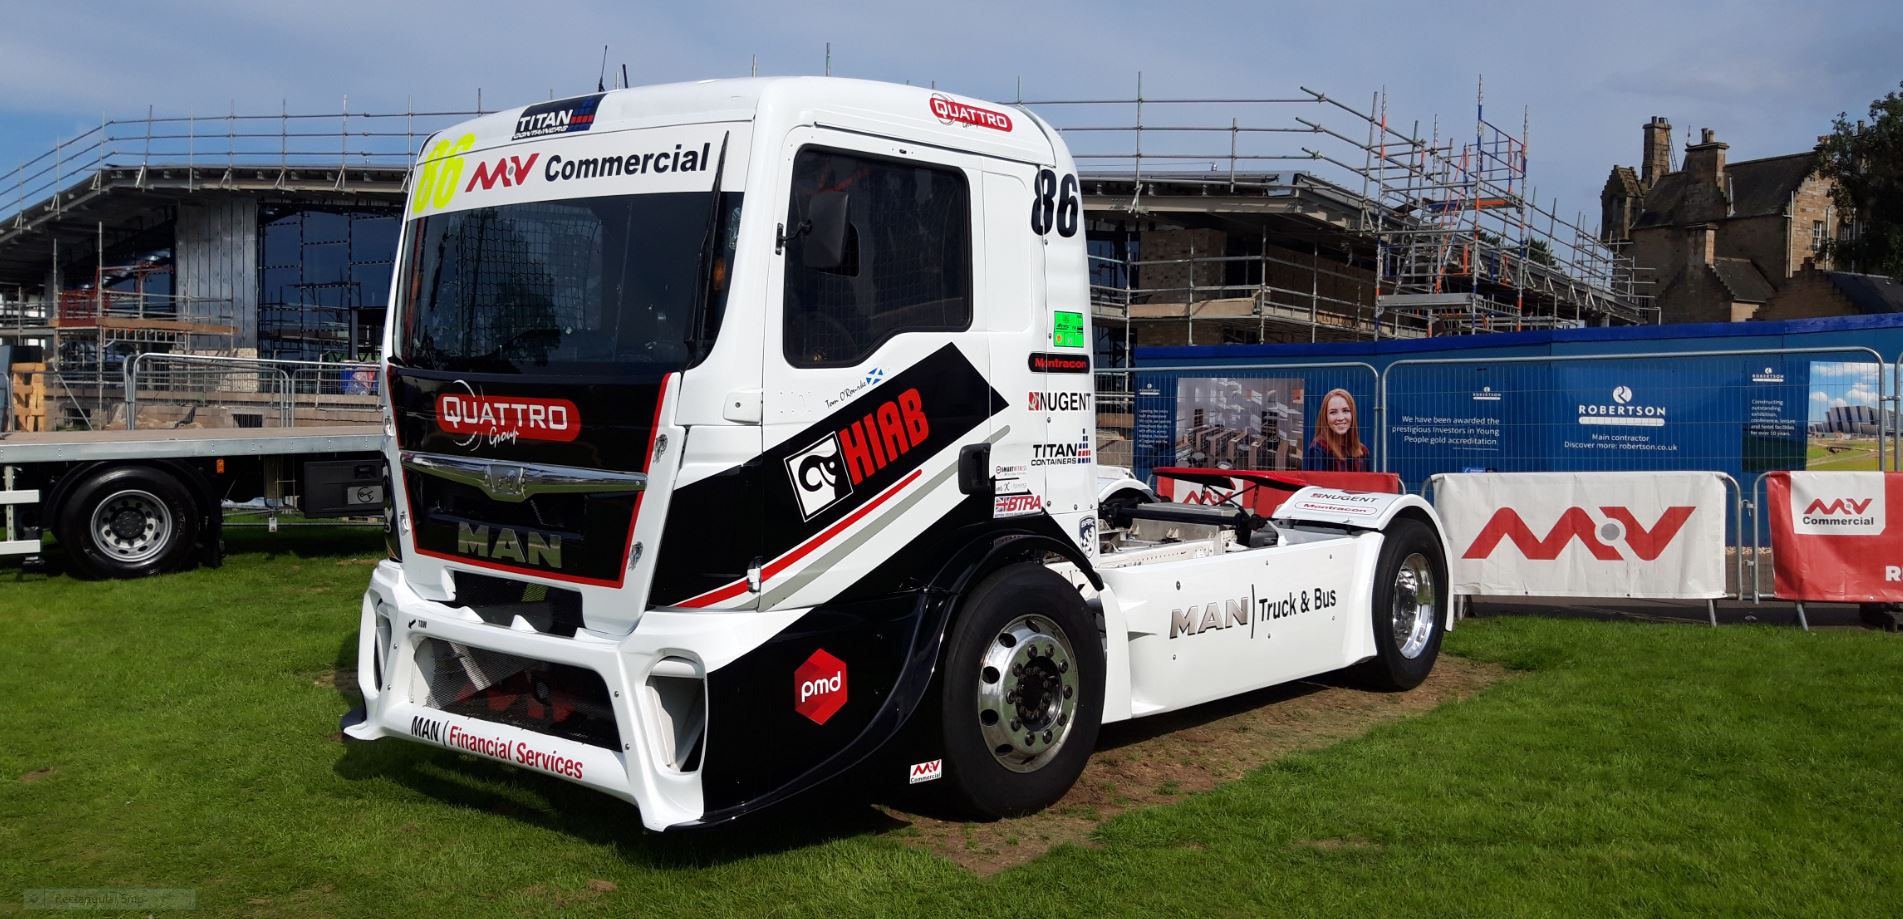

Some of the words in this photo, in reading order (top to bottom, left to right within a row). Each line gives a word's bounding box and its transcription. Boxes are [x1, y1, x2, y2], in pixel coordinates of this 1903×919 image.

[519, 109, 573, 132] TITAN
[934, 100, 1008, 128] QUATTRO
[544, 142, 711, 182] Commercial
[412, 132, 476, 214] 86
[1031, 169, 1079, 238] 86
[1034, 357, 1086, 369] Montracon
[1040, 391, 1091, 411] NUGENT
[442, 396, 568, 430] QUATTRO
[1578, 405, 1666, 416] ROBERTSON
[1433, 416, 1451, 424] been
[1453, 416, 1485, 425] awarded
[1487, 417, 1500, 425] the
[488, 426, 519, 448] Group
[838, 388, 930, 486] HIAB
[1392, 425, 1431, 434] prestigious
[1476, 428, 1500, 437] Young
[1404, 435, 1429, 444] People
[1430, 436, 1446, 445] gold
[1592, 433, 1610, 441] Main
[1033, 443, 1077, 458] TITAN
[1564, 441, 1595, 449] Discover
[1596, 442, 1618, 450] more:
[1618, 442, 1679, 451] robertson.co.uk
[1030, 457, 1077, 466] CONTAINERS
[1006, 495, 1041, 512] BTRA
[1322, 493, 1379, 503] NUGENT
[1802, 516, 1874, 527] Commercial
[458, 521, 562, 568] MAN
[1885, 565, 1903, 582] R
[1169, 597, 1249, 639] MAN
[1259, 592, 1297, 622] Truck
[1300, 590, 1311, 613] &
[1314, 588, 1337, 611] Bus
[801, 671, 841, 703] pmd
[411, 716, 440, 742] MAN
[449, 725, 513, 761] Financial
[516, 742, 584, 780] Services
